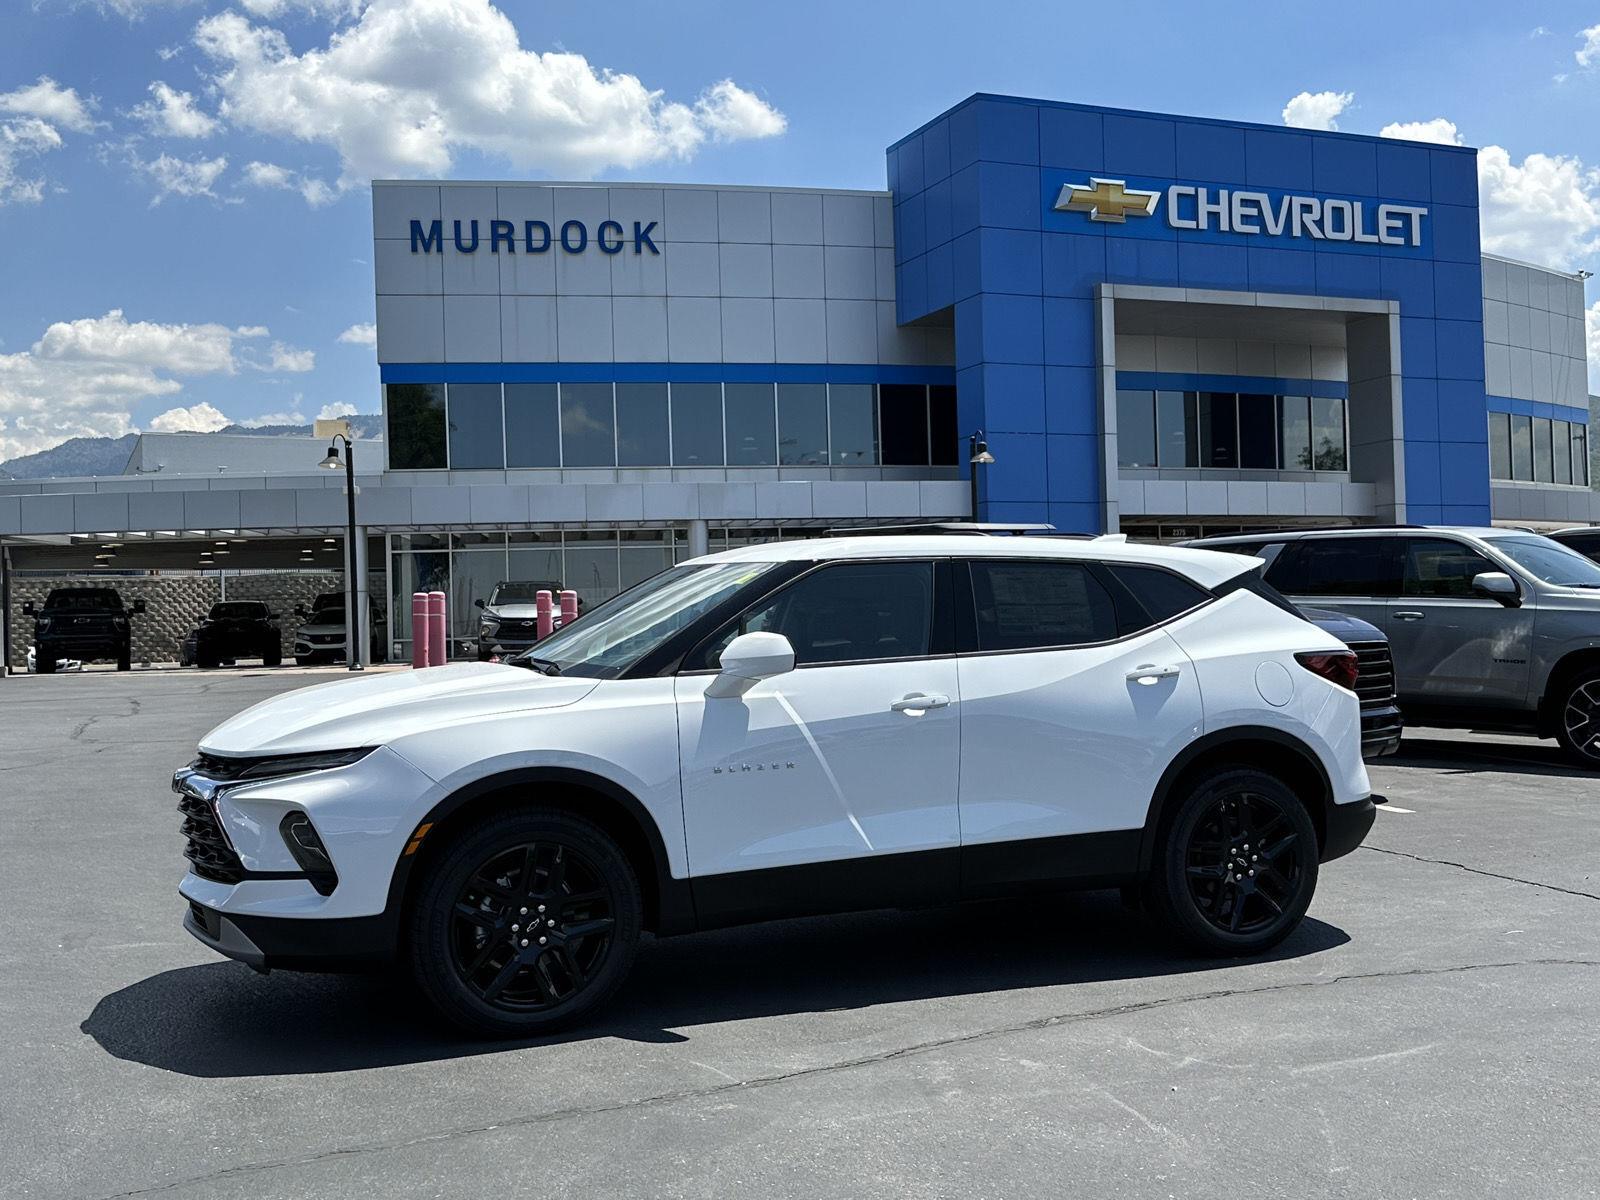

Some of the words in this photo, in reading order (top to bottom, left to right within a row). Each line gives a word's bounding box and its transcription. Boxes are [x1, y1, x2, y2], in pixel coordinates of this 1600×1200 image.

[1167, 185, 1429, 247] CHEVROLET
[409, 219, 661, 255] MURDOCK
[713, 761, 795, 775] BLAZER
